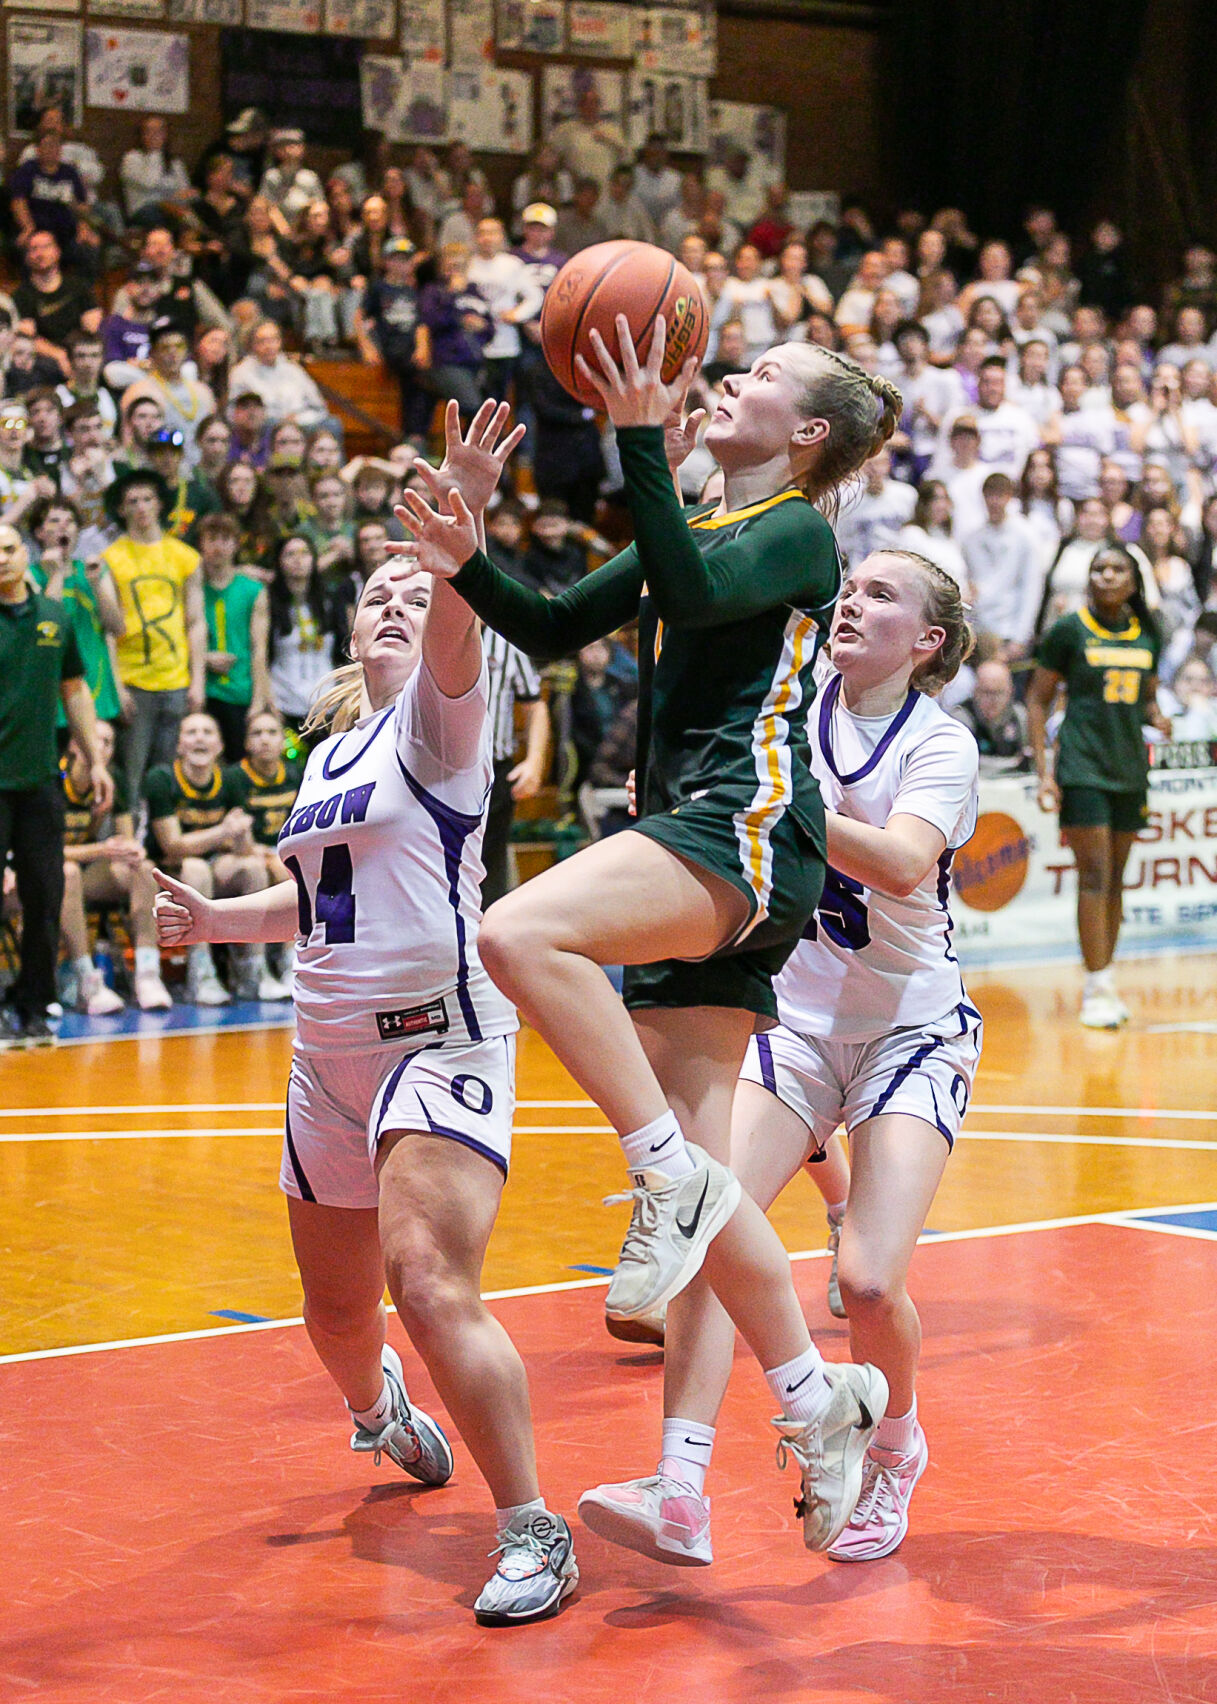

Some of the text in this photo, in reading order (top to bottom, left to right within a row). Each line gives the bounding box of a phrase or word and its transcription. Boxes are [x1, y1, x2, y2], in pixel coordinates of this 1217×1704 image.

[130, 574, 178, 665] R
[278, 781, 376, 843] XBOW
[284, 843, 356, 947] 14
[801, 862, 872, 951] 5
[450, 1074, 493, 1116] O
[950, 1073, 969, 1118] O
